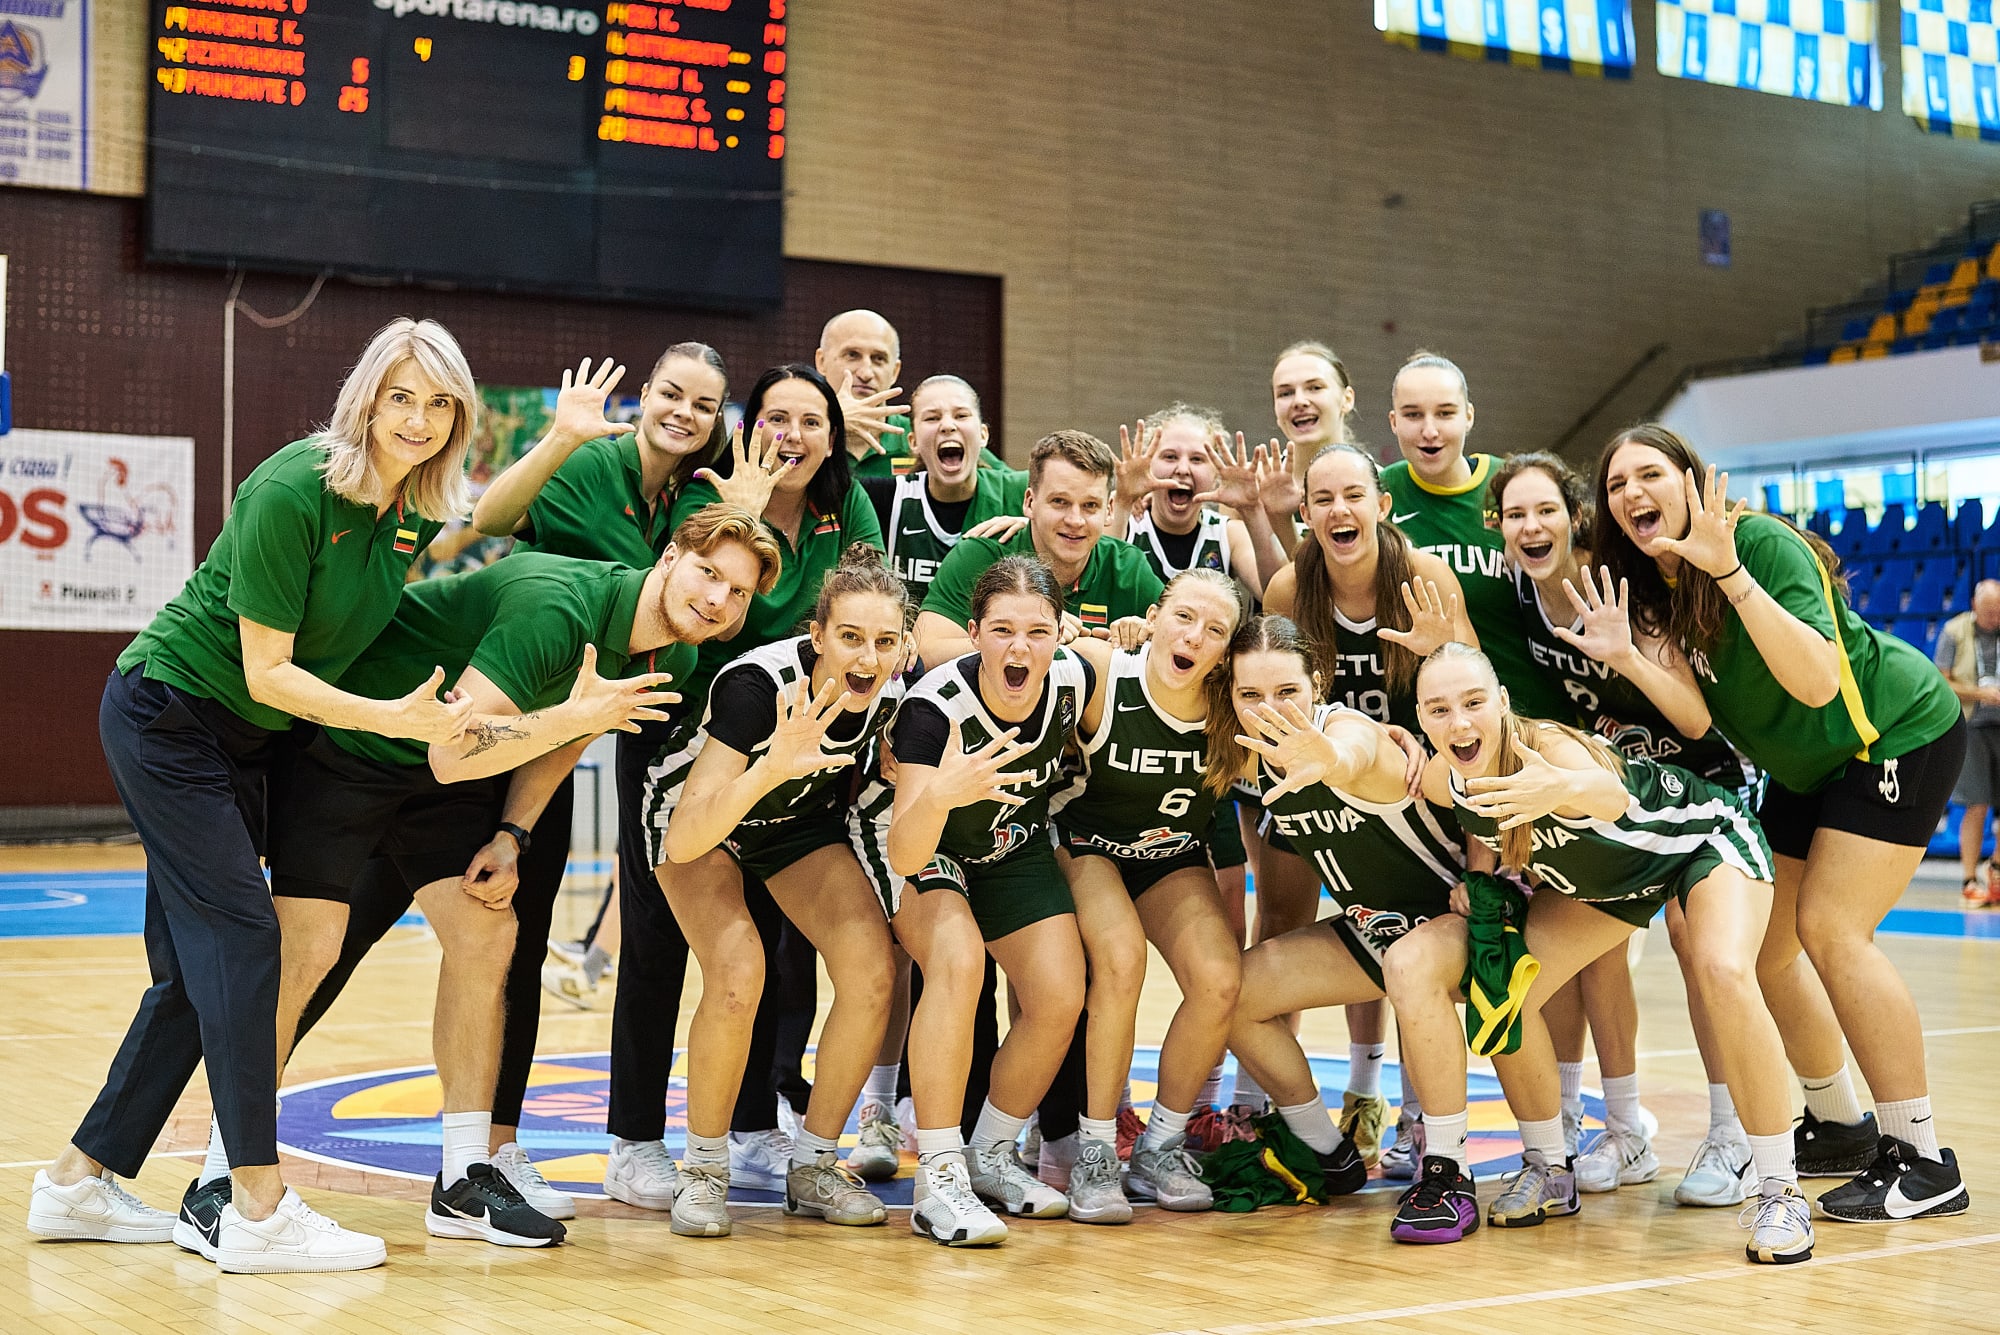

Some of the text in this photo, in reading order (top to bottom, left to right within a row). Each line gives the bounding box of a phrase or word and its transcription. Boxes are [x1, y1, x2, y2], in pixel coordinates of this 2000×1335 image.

[893, 554, 942, 583] LIE
[1345, 689, 1391, 723] 19
[1157, 787, 1197, 818] 6
[1313, 848, 1353, 892] 11
